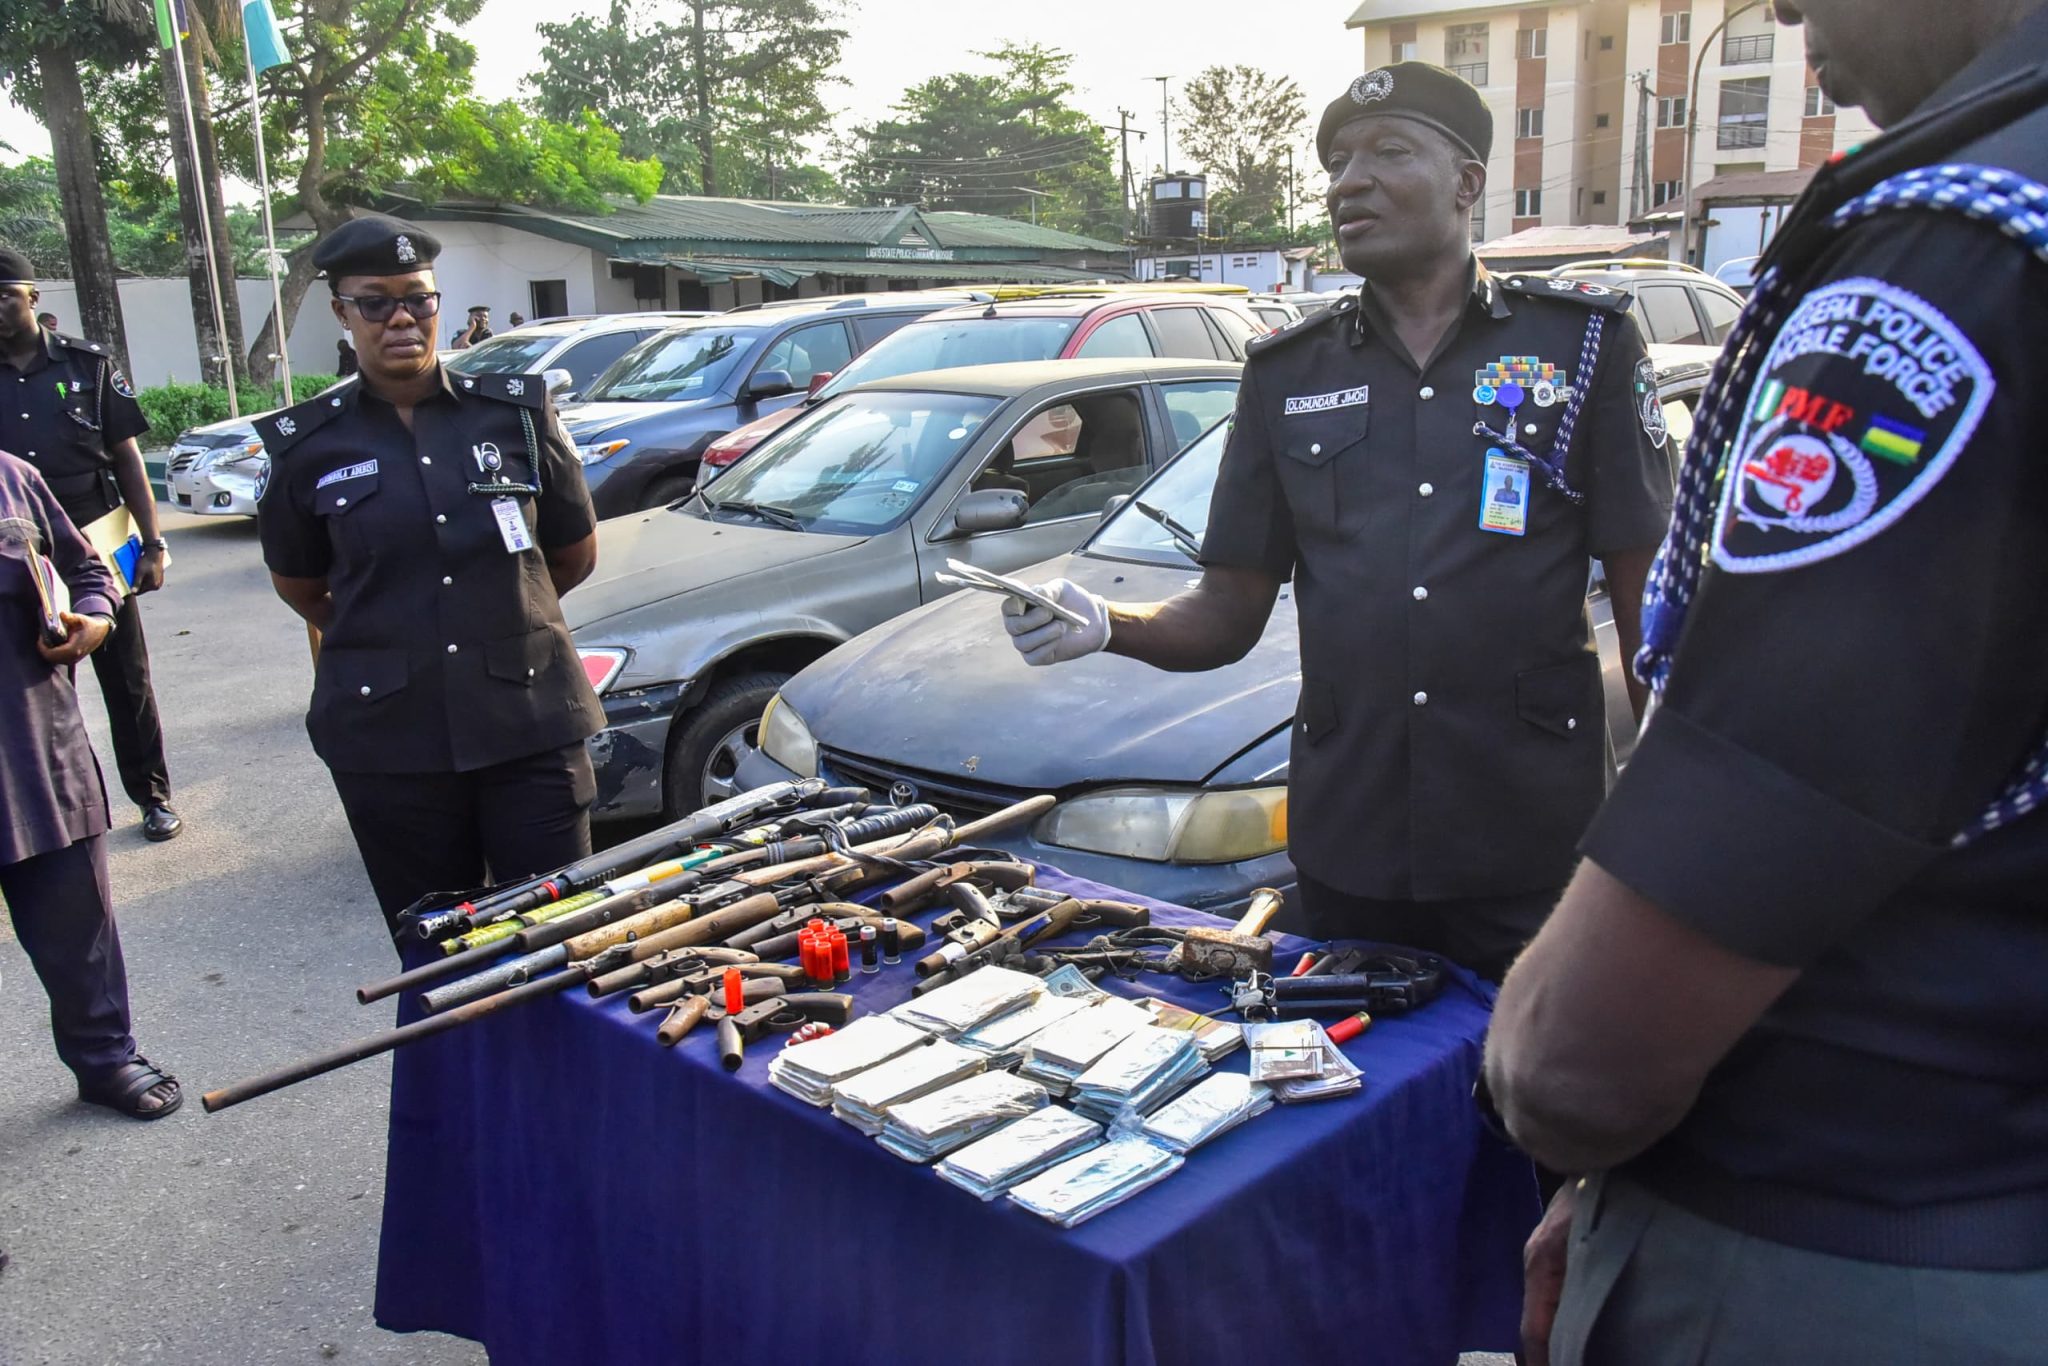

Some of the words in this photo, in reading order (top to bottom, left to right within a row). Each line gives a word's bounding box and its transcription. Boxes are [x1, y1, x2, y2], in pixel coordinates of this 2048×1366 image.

[866, 246, 882, 258] LAGOS
[882, 247, 896, 259] STATE
[896, 247, 912, 259] POLICE
[935, 249, 954, 260] MOSQUE
[1862, 300, 1968, 389] POLICE
[1772, 325, 1850, 370] MOBILE
[1848, 332, 1955, 418] FORCE
[1288, 395, 1339, 411] OLOHUNDARE
[1341, 390, 1365, 404] JIMOH
[1775, 386, 1853, 431] PMF
[351, 463, 374, 476] ADEBISI
